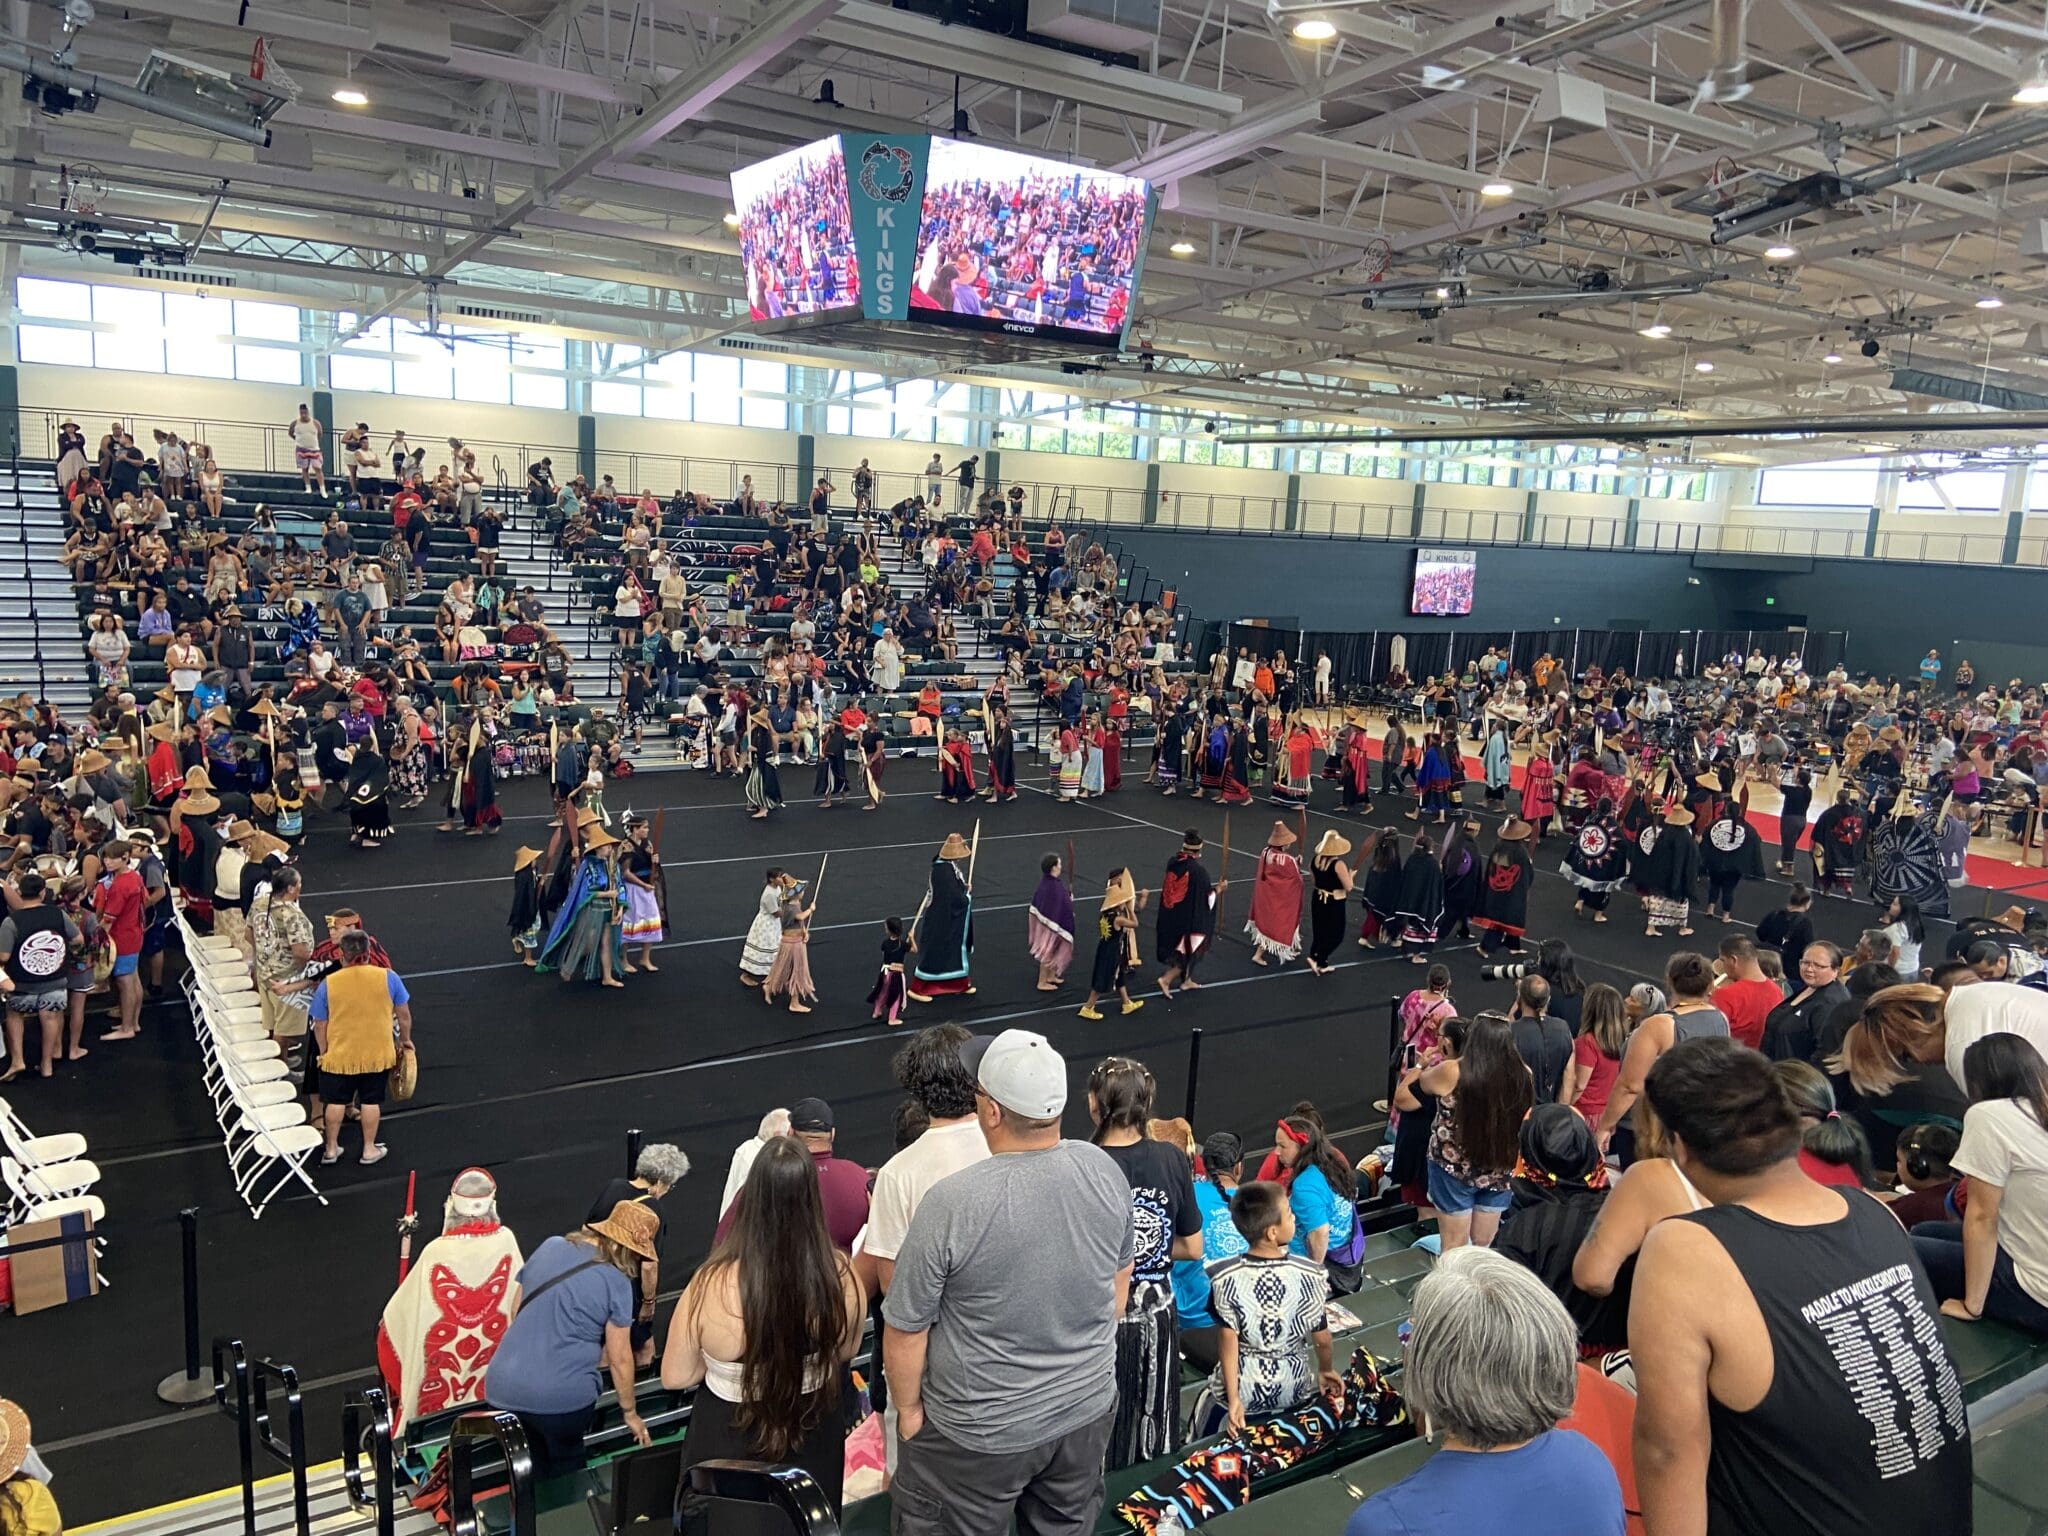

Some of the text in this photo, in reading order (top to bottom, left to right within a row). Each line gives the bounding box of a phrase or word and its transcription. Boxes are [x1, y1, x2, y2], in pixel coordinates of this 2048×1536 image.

[876, 207, 895, 314] KINGS
[1801, 1291, 1842, 1324] PADDLE
[1837, 1287, 1853, 1306] TO
